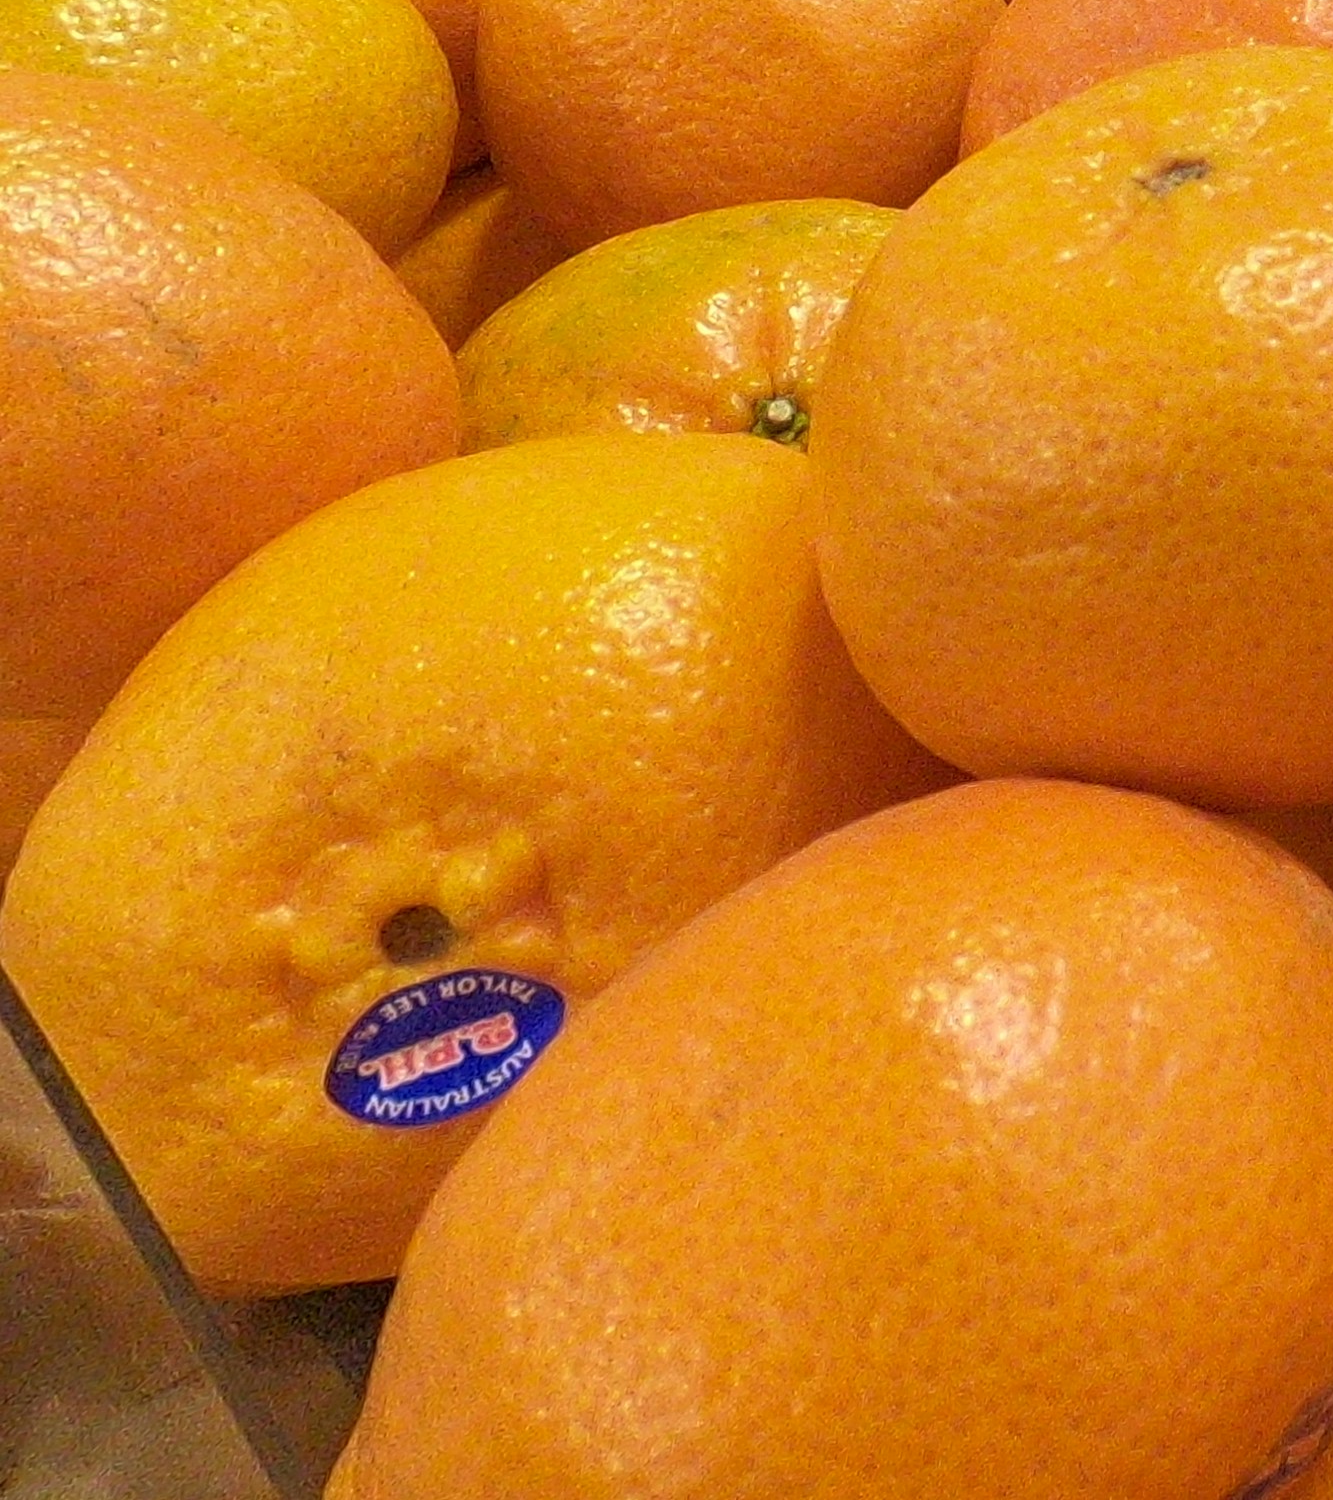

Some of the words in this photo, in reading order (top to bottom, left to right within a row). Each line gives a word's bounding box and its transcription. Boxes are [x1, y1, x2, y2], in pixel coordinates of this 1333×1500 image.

[439, 975, 537, 1004] TAYLOR
[380, 990, 427, 1022] LEE
[365, 1039, 532, 1117] AUSTRALIAN
